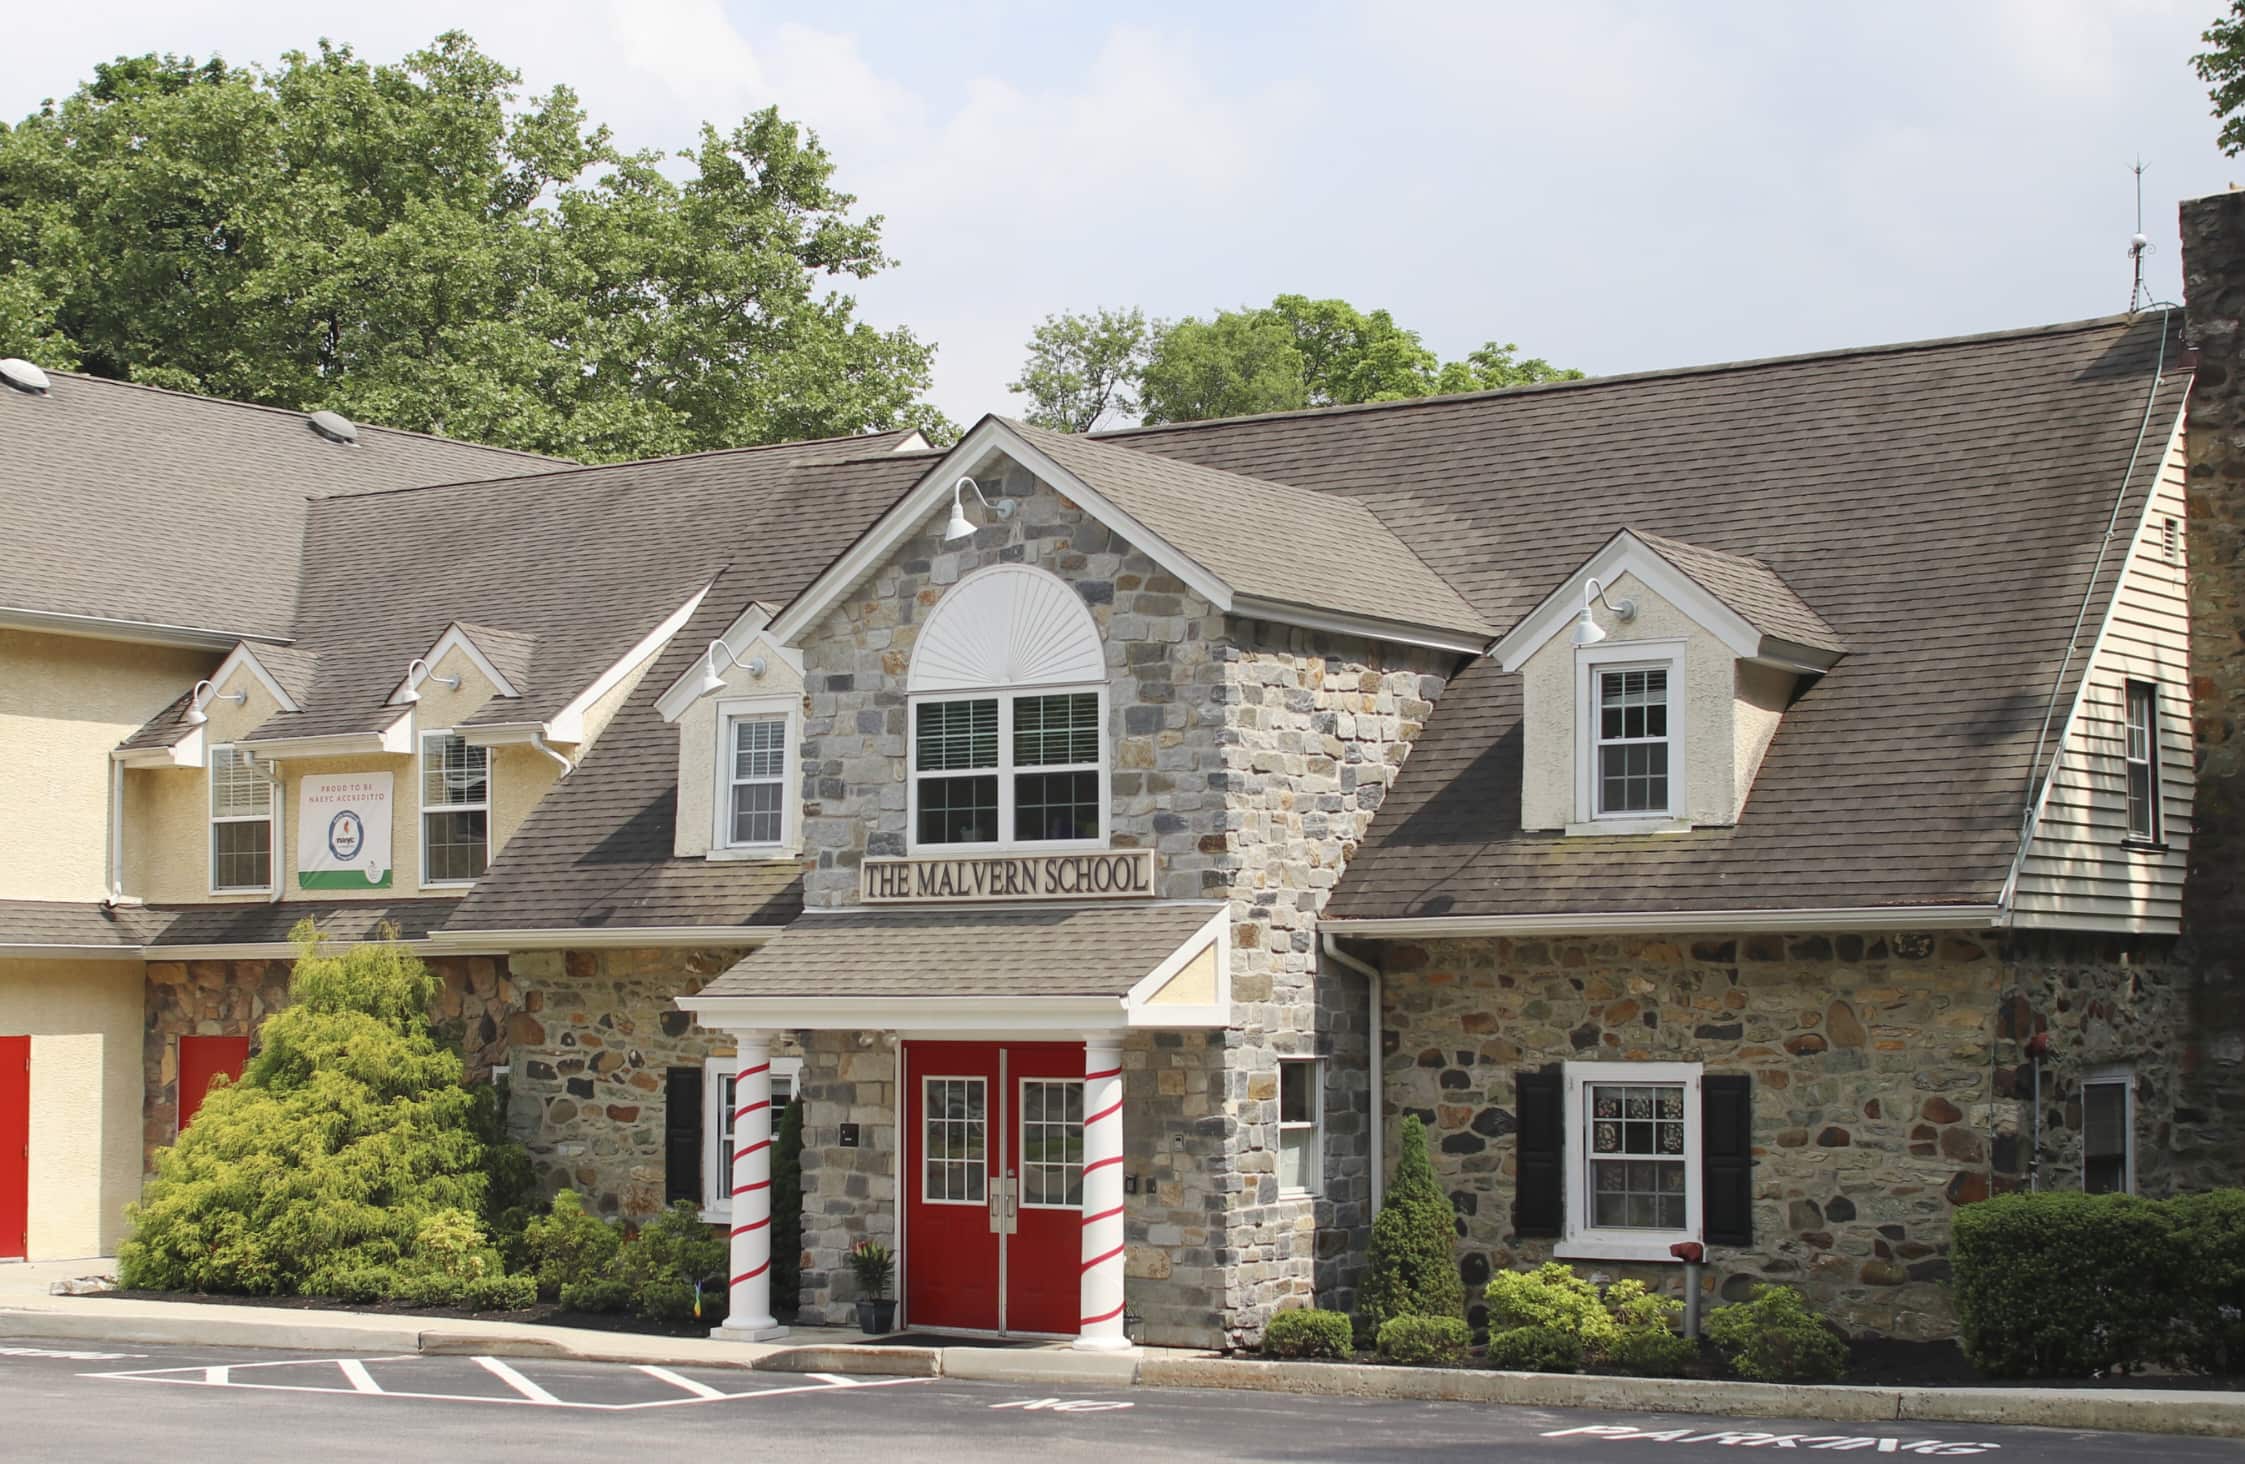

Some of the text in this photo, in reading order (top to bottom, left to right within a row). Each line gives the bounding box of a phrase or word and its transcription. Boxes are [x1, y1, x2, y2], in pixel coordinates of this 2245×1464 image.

[320, 784, 347, 793] PROUD
[350, 783, 361, 792] TO
[864, 856, 1149, 897] THE MALVERN SCHOOL
[1538, 1424, 2001, 1456] PARKING
